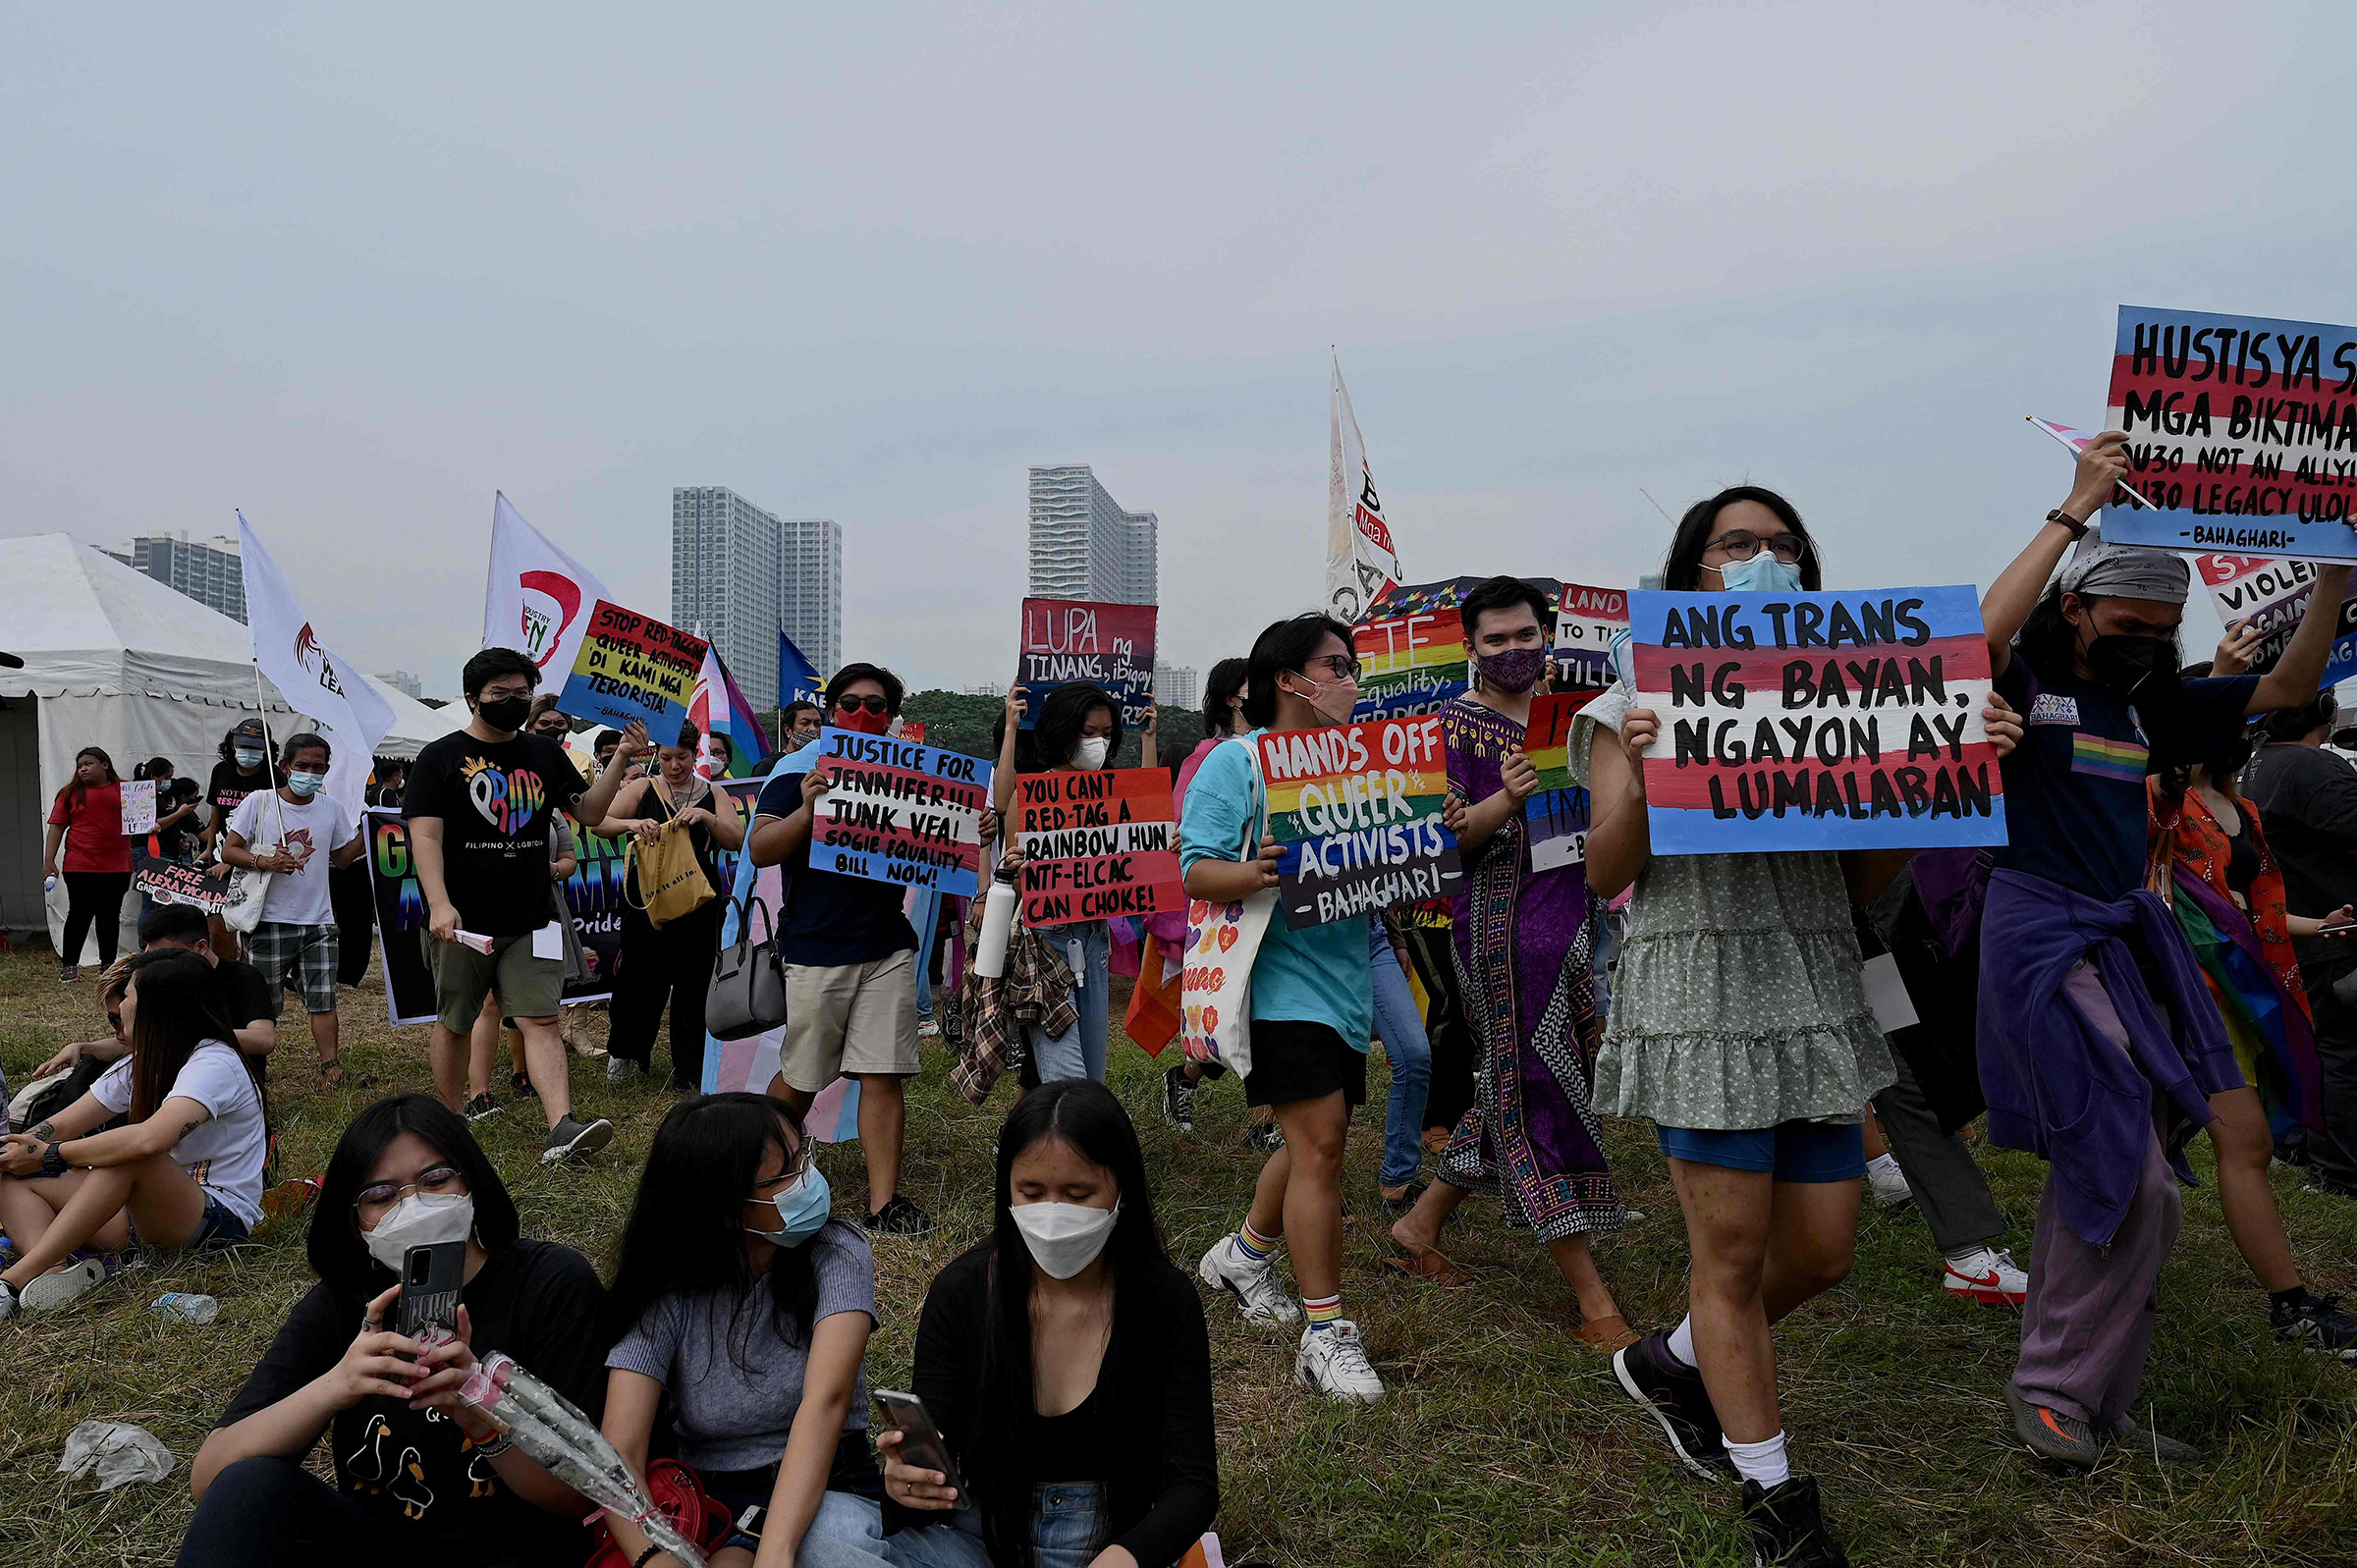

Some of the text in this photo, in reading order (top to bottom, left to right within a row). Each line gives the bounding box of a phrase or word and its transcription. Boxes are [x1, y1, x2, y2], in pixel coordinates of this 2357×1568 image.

[2132, 323, 2357, 396] HUSTISYA S
[2122, 389, 2212, 437] MGA
[2196, 446, 2244, 475] NOT
[2249, 451, 2283, 481] AN
[2294, 455, 2357, 487] ALLY!
[2192, 482, 2293, 516] LEGACY
[2179, 525, 2295, 549] -BAHAGHARI-
[599, 610, 641, 633] STOP
[1564, 588, 1622, 614] LAND
[1028, 608, 1132, 667] LUPA ng
[1562, 623, 1584, 639] TO
[1663, 599, 1931, 651] ANG TRANS
[596, 633, 700, 681] QUEER ACTIVISTS!
[619, 659, 657, 685] KAMI
[658, 673, 683, 697] MGA
[1026, 654, 1152, 693] TINANG, ibigay
[587, 672, 668, 715] TERORISTA!
[1671, 655, 1970, 710] NG BAYAN,
[826, 734, 975, 782] JUSTICE FOR
[1264, 717, 1440, 780] HANDS OFF
[1674, 713, 1968, 769] NGAYON AY
[828, 767, 974, 815] JENNIFER!!!
[1022, 778, 1059, 803] YOU
[1299, 769, 1414, 836] QUEER
[1709, 762, 1992, 821] LUMALABAN
[826, 799, 959, 847] JUNK VFA!
[1024, 797, 1131, 833] RED-TAG A
[824, 830, 963, 873] SOGIE EQUALITY
[1025, 827, 1124, 861] RAINBOW,
[1297, 812, 1444, 884] ACTIVISTS
[137, 869, 180, 892] ALEXA
[165, 865, 205, 886] FREE
[836, 853, 938, 889] BILL NOW!
[1025, 857, 1134, 892] NTF-ELCAC
[1027, 885, 1156, 923] CAN CHOKE!
